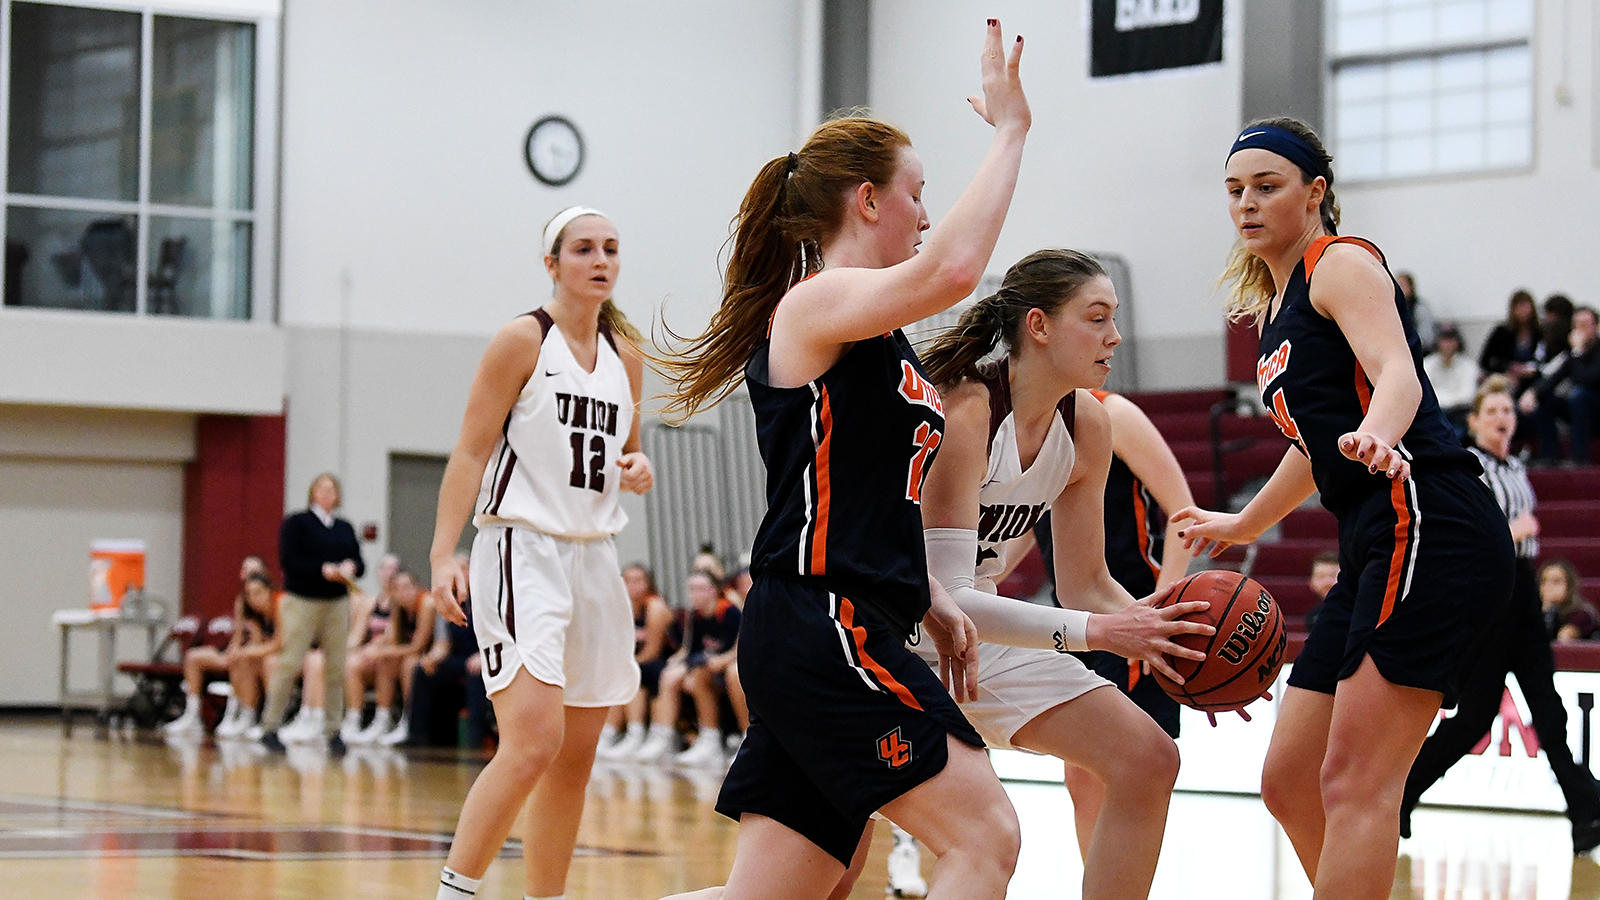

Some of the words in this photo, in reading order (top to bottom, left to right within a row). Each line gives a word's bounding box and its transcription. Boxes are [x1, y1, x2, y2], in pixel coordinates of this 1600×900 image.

[555, 392, 619, 436] UNION
[569, 432, 606, 493] 12
[1216, 589, 1272, 665] Wilson
[483, 642, 503, 678] U
[879, 730, 910, 768] UC
